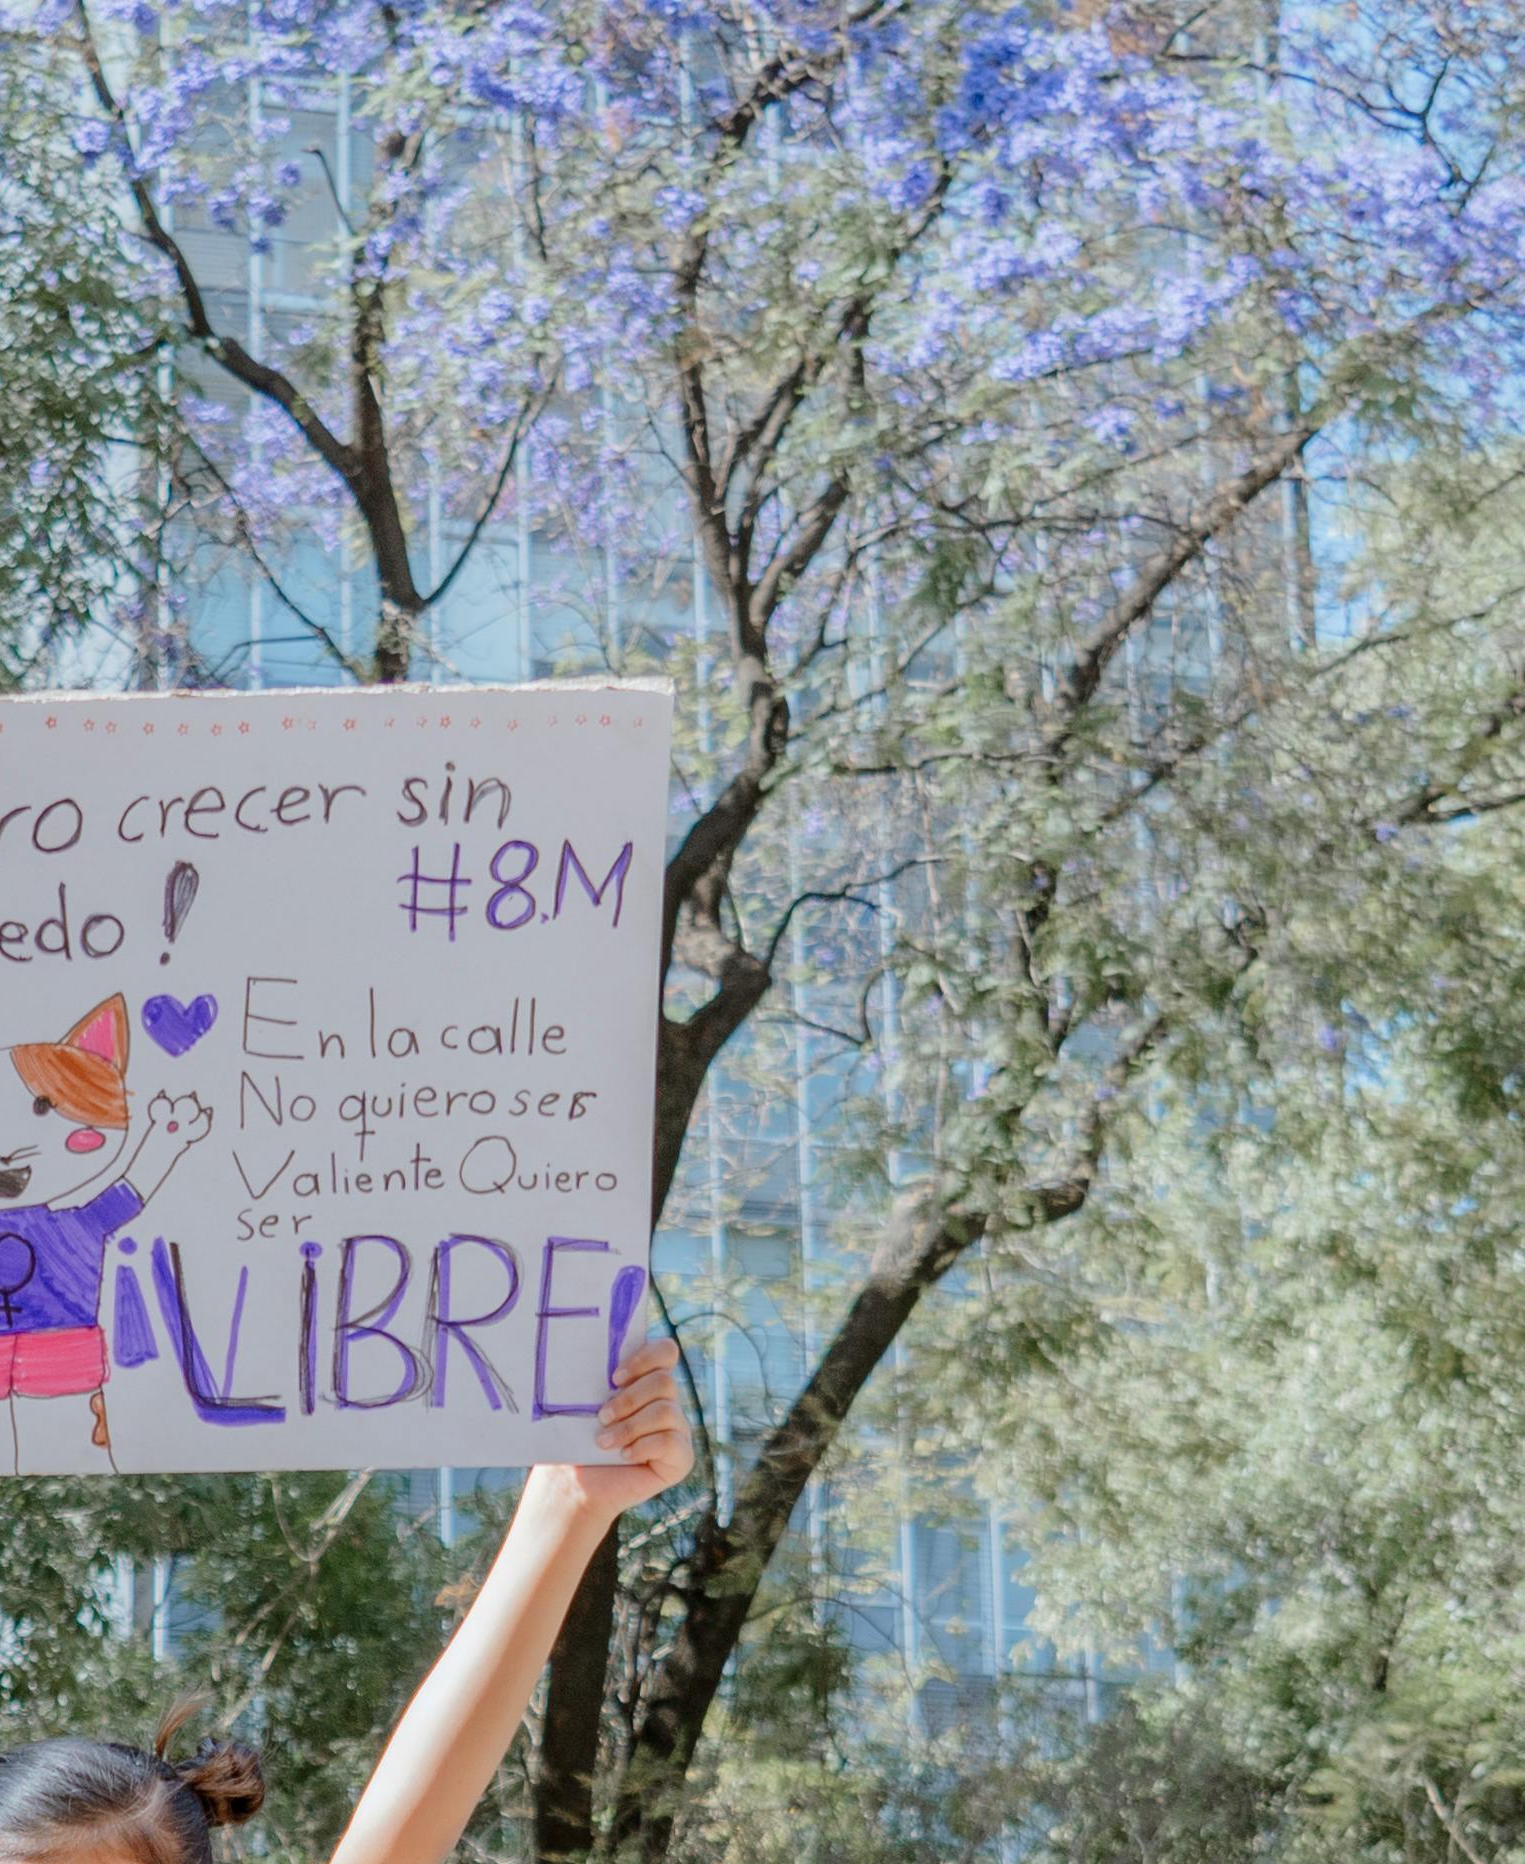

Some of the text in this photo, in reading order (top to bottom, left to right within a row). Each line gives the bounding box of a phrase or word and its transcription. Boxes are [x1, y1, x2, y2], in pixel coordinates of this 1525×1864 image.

[118, 784, 366, 842] crecer
[396, 762, 512, 829] sin
[239, 1070, 316, 1129] No
[232, 1135, 618, 1199] Valiente Quiero
[236, 1208, 313, 1241] ser
